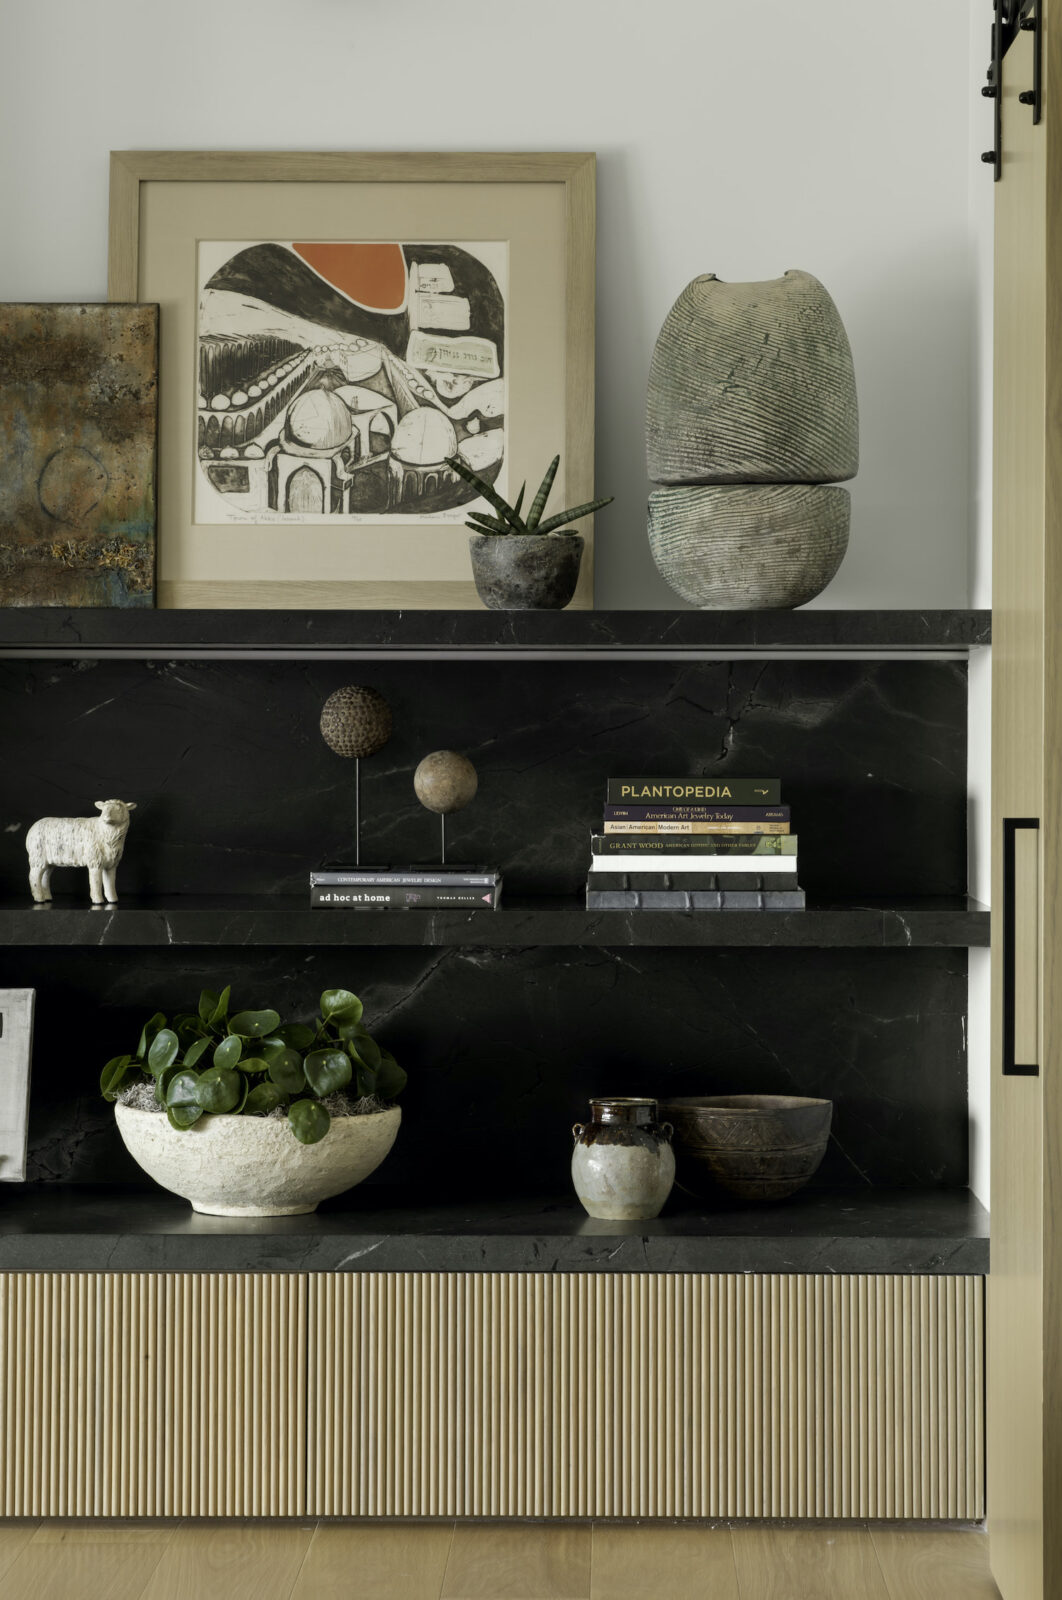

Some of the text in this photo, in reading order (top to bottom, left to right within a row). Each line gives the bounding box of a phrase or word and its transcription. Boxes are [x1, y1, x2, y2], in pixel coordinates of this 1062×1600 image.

[621, 785, 732, 798] PLANTOPEDIA
[690, 812, 714, 821] Jewelry
[715, 812, 734, 821] Today
[319, 893, 391, 902] ad hoc at home
